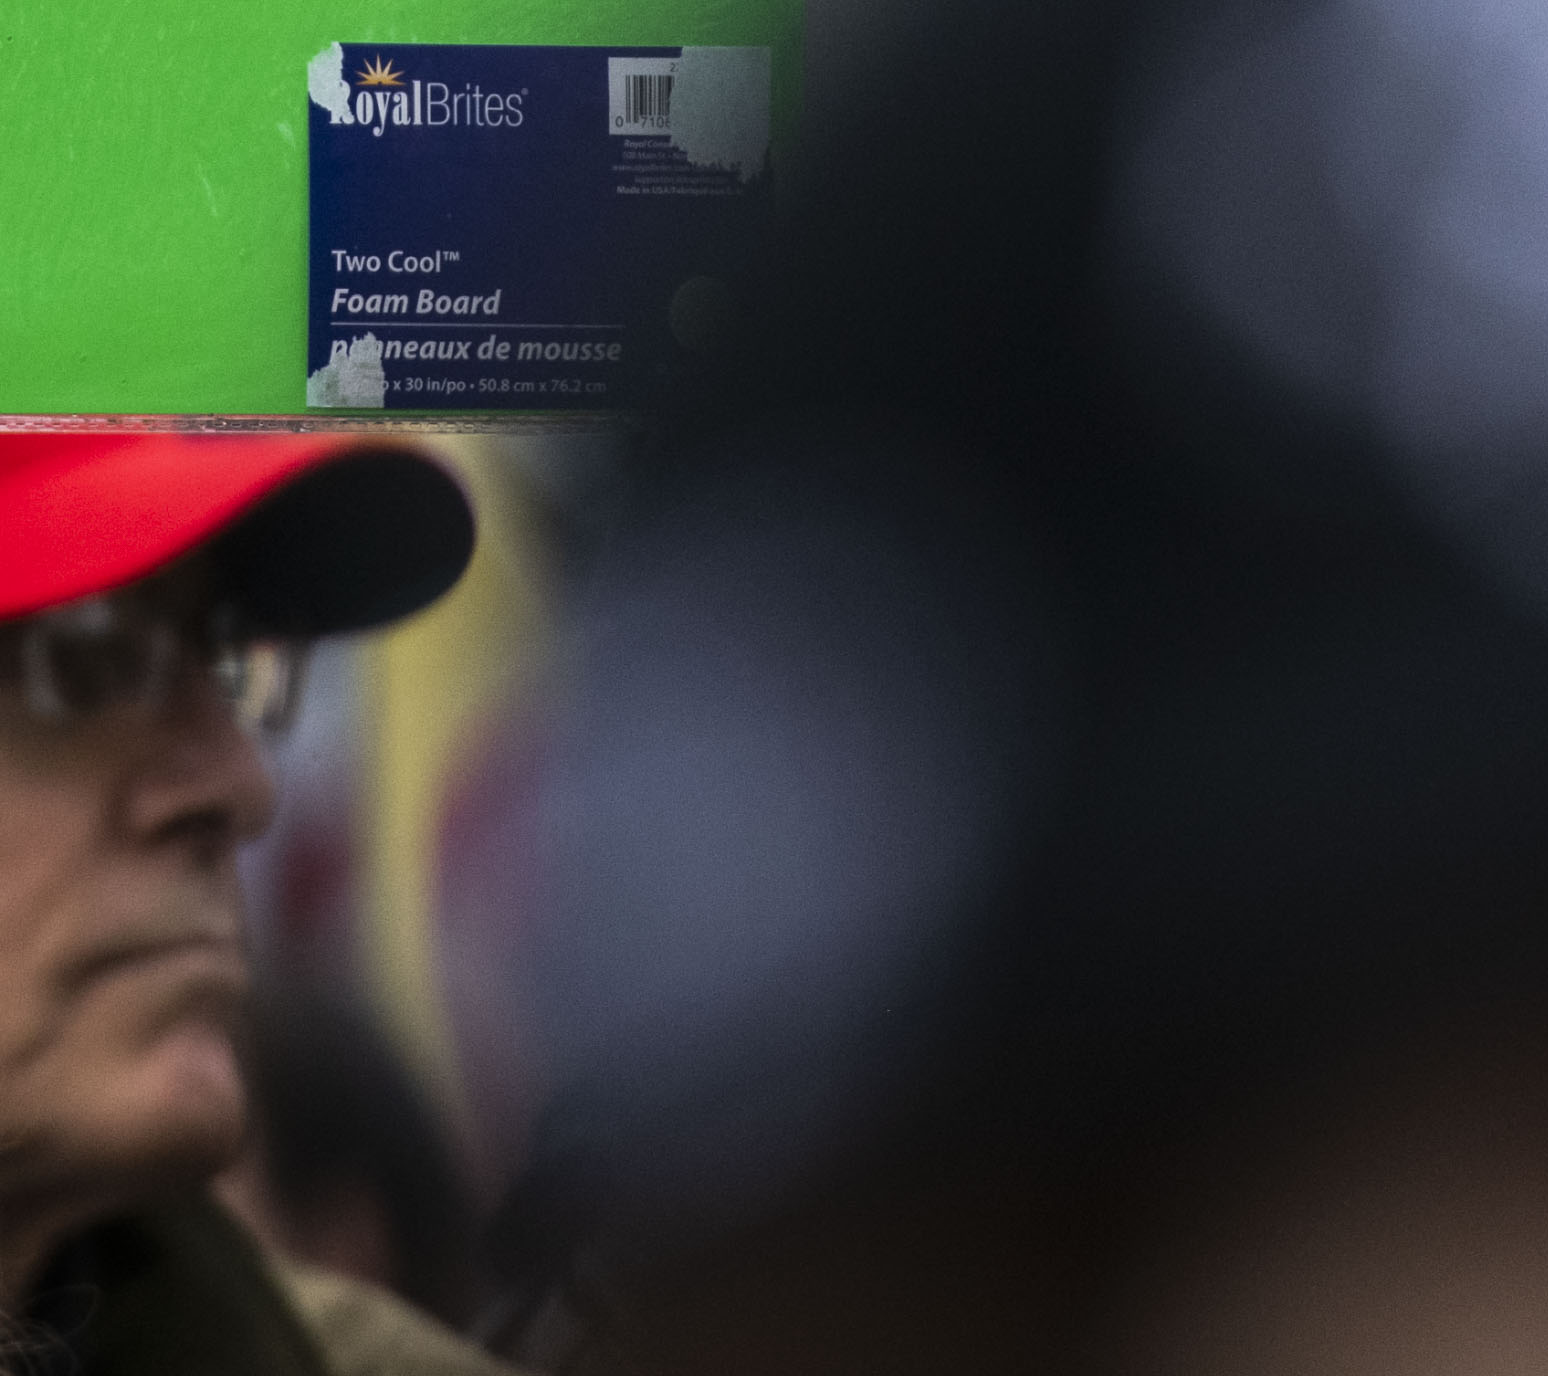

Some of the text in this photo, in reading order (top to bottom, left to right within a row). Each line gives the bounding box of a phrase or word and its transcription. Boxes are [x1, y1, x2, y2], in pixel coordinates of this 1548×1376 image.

[331, 250, 381, 272] Two
[331, 288, 502, 315] Foam Board
[329, 334, 623, 367] pneaux de mousse
[393, 380, 402, 391] x
[405, 377, 423, 391] 30
[427, 377, 466, 395] in/po
[478, 378, 510, 392] 50.8
[513, 381, 535, 393] cm
[551, 379, 582, 393] 76.2
